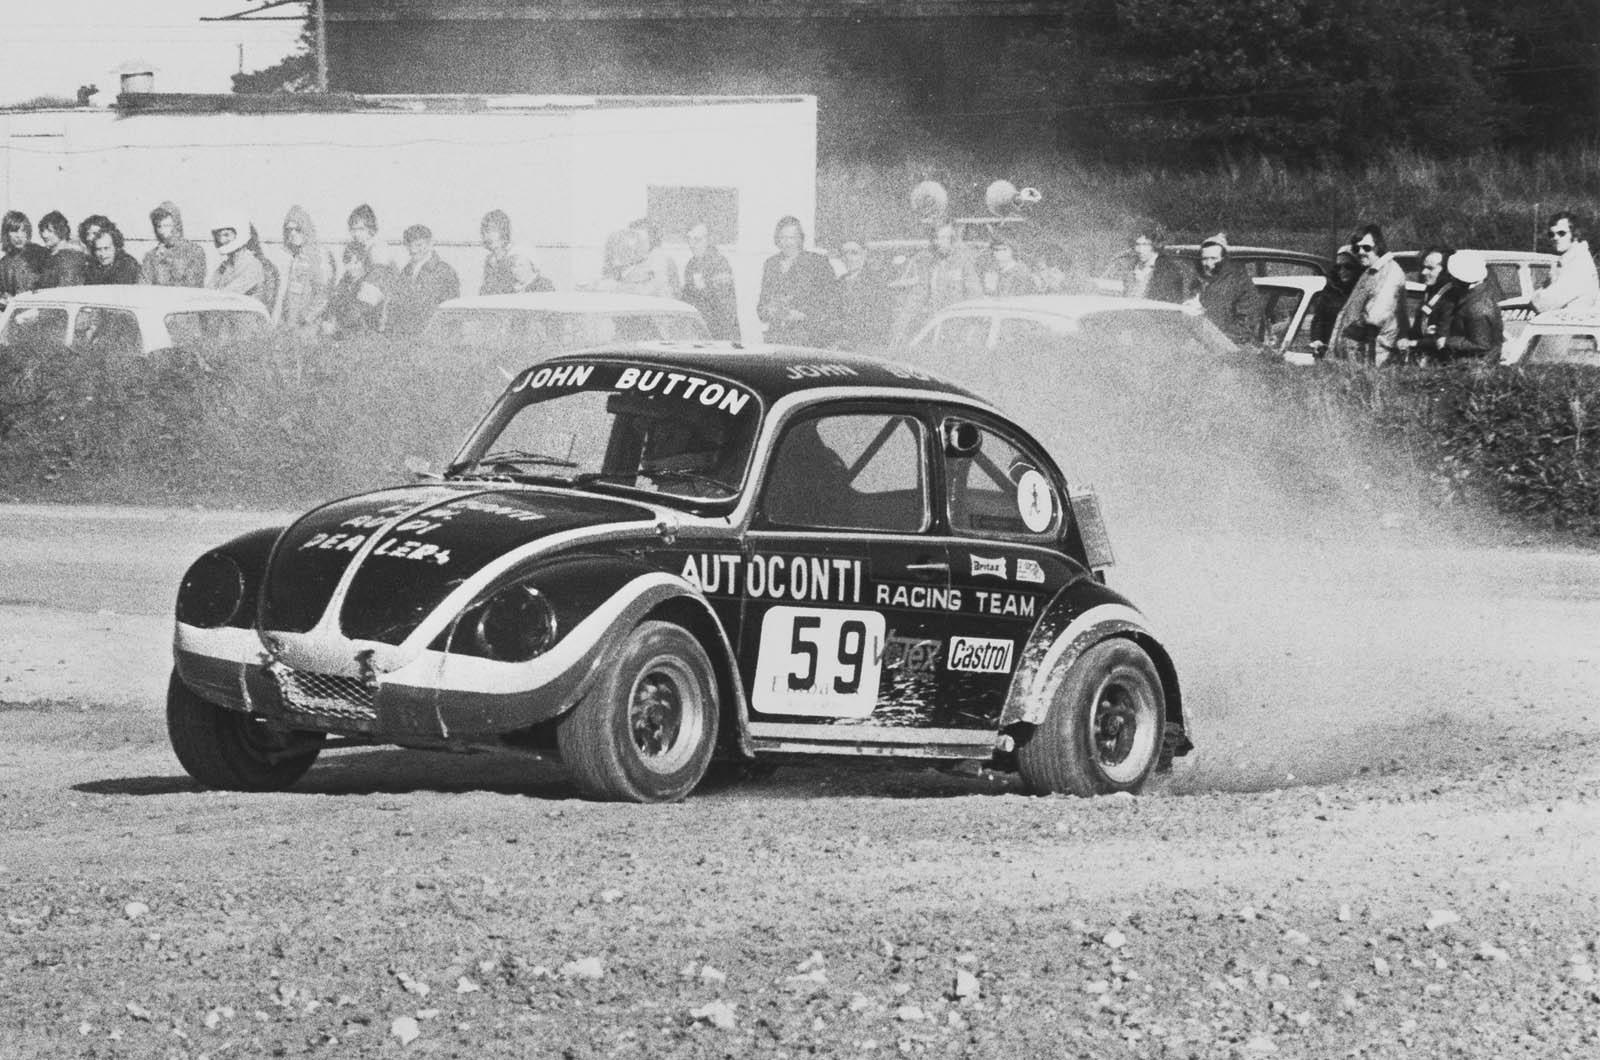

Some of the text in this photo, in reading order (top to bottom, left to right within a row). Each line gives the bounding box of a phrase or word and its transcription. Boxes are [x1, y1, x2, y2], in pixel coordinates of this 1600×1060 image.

[512, 365, 750, 415] JOHN BUTTON
[786, 364, 859, 380] JOHN
[681, 554, 861, 602] AUTOCONTI
[876, 585, 1035, 617] RACING TEAM
[787, 616, 867, 694] 59
[950, 639, 1011, 671] Castrol
